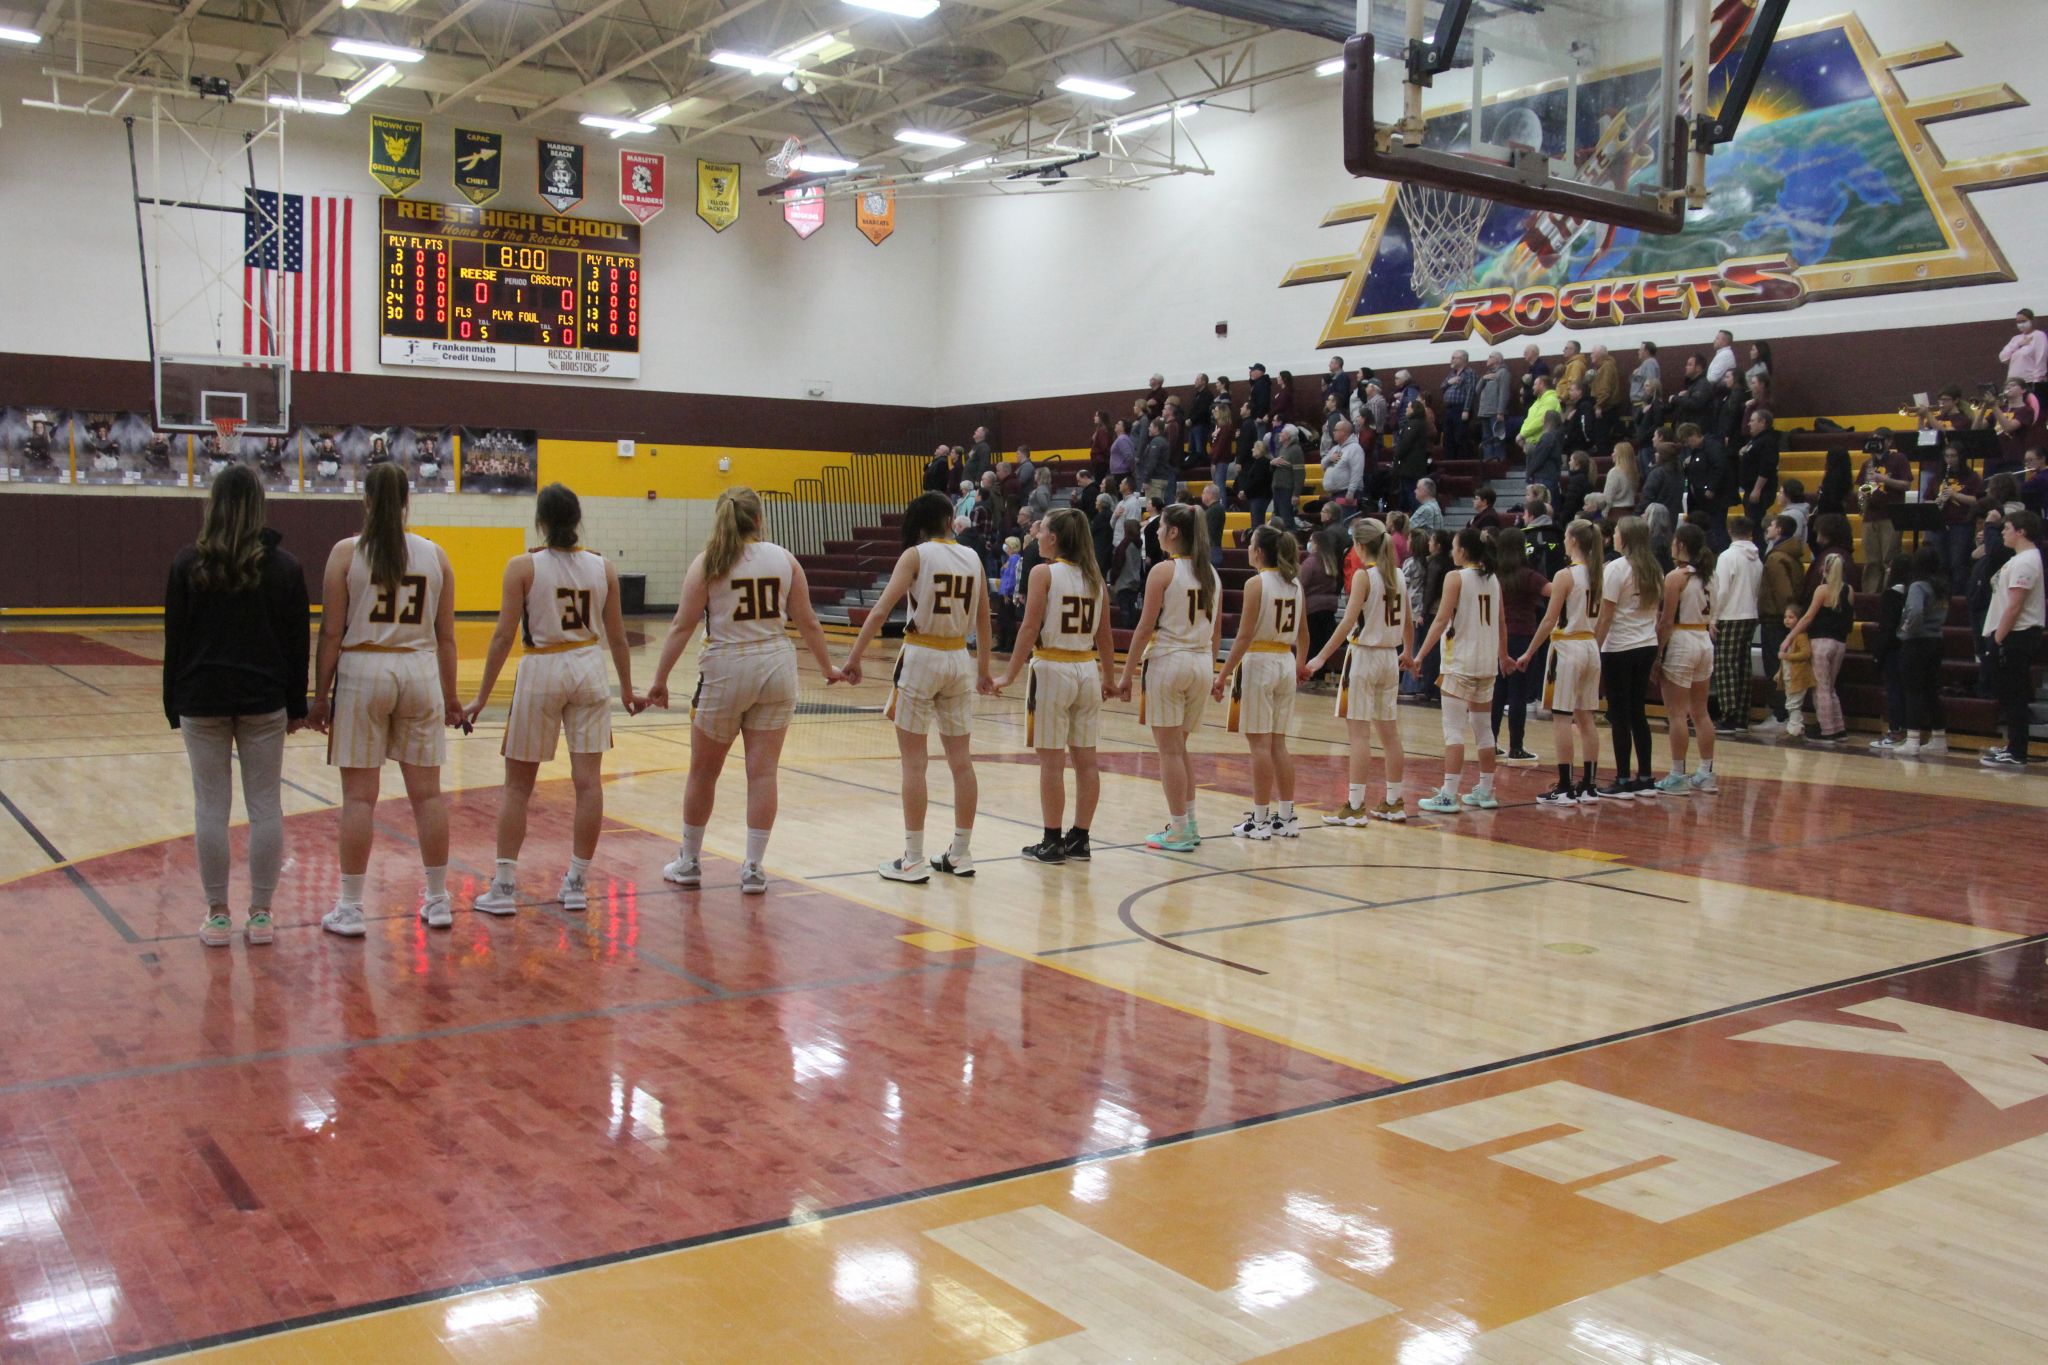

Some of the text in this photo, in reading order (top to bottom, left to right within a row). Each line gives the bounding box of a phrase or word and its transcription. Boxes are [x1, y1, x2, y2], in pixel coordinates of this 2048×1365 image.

[374, 120, 402, 130] BROWN
[466, 133, 490, 143] CAPAC
[547, 142, 574, 152] HARBOR
[550, 150, 572, 158] BEACH
[372, 163, 420, 176] GREEN DEVILS
[466, 177, 488, 186] CHIEFS
[548, 186, 574, 196] PIRATES
[398, 200, 628, 240] REESE HIGH SCHOOL
[389, 235, 443, 250] PLY FL PTS
[442, 222, 580, 248] Home of the Rockets
[396, 248, 446, 265] 3 0 0
[500, 246, 545, 270] 8:00
[586, 254, 635, 268] PLY FL PTS
[390, 262, 446, 280] 10 0 0
[460, 267, 498, 282] REESE
[592, 266, 638, 282] 3 0 0
[390, 278, 446, 294] 11 0 0
[475, 282, 488, 304] 0
[587, 280, 637, 296] 10 0 0
[386, 292, 445, 308] 24 0 0
[516, 288, 521, 304] 1
[562, 290, 574, 311] 0
[587, 294, 637, 310] 11 0 0
[1430, 253, 1807, 346] ROCKETS
[387, 306, 445, 323] 30 0 0
[455, 306, 472, 318] FLS
[492, 309, 540, 324] PLYR FOUL
[558, 314, 574, 326] FLS
[587, 308, 637, 323] 13 0 0
[460, 321, 471, 338] 0
[564, 328, 573, 346] 0
[587, 322, 637, 337] 14 0 0
[432, 342, 496, 354] Frankenmuth
[548, 349, 573, 360] REESE
[442, 352, 469, 362] Credit
[471, 356, 496, 364] Union
[560, 360, 598, 373] BOOSTERS
[369, 574, 427, 625] 33
[731, 577, 781, 622] 30
[933, 573, 975, 616] 24
[556, 587, 592, 632] 31
[1061, 595, 1096, 635] 20
[1274, 598, 1296, 634] 13
[1382, 594, 1401, 628] 12
[1478, 594, 1491, 627] 11
